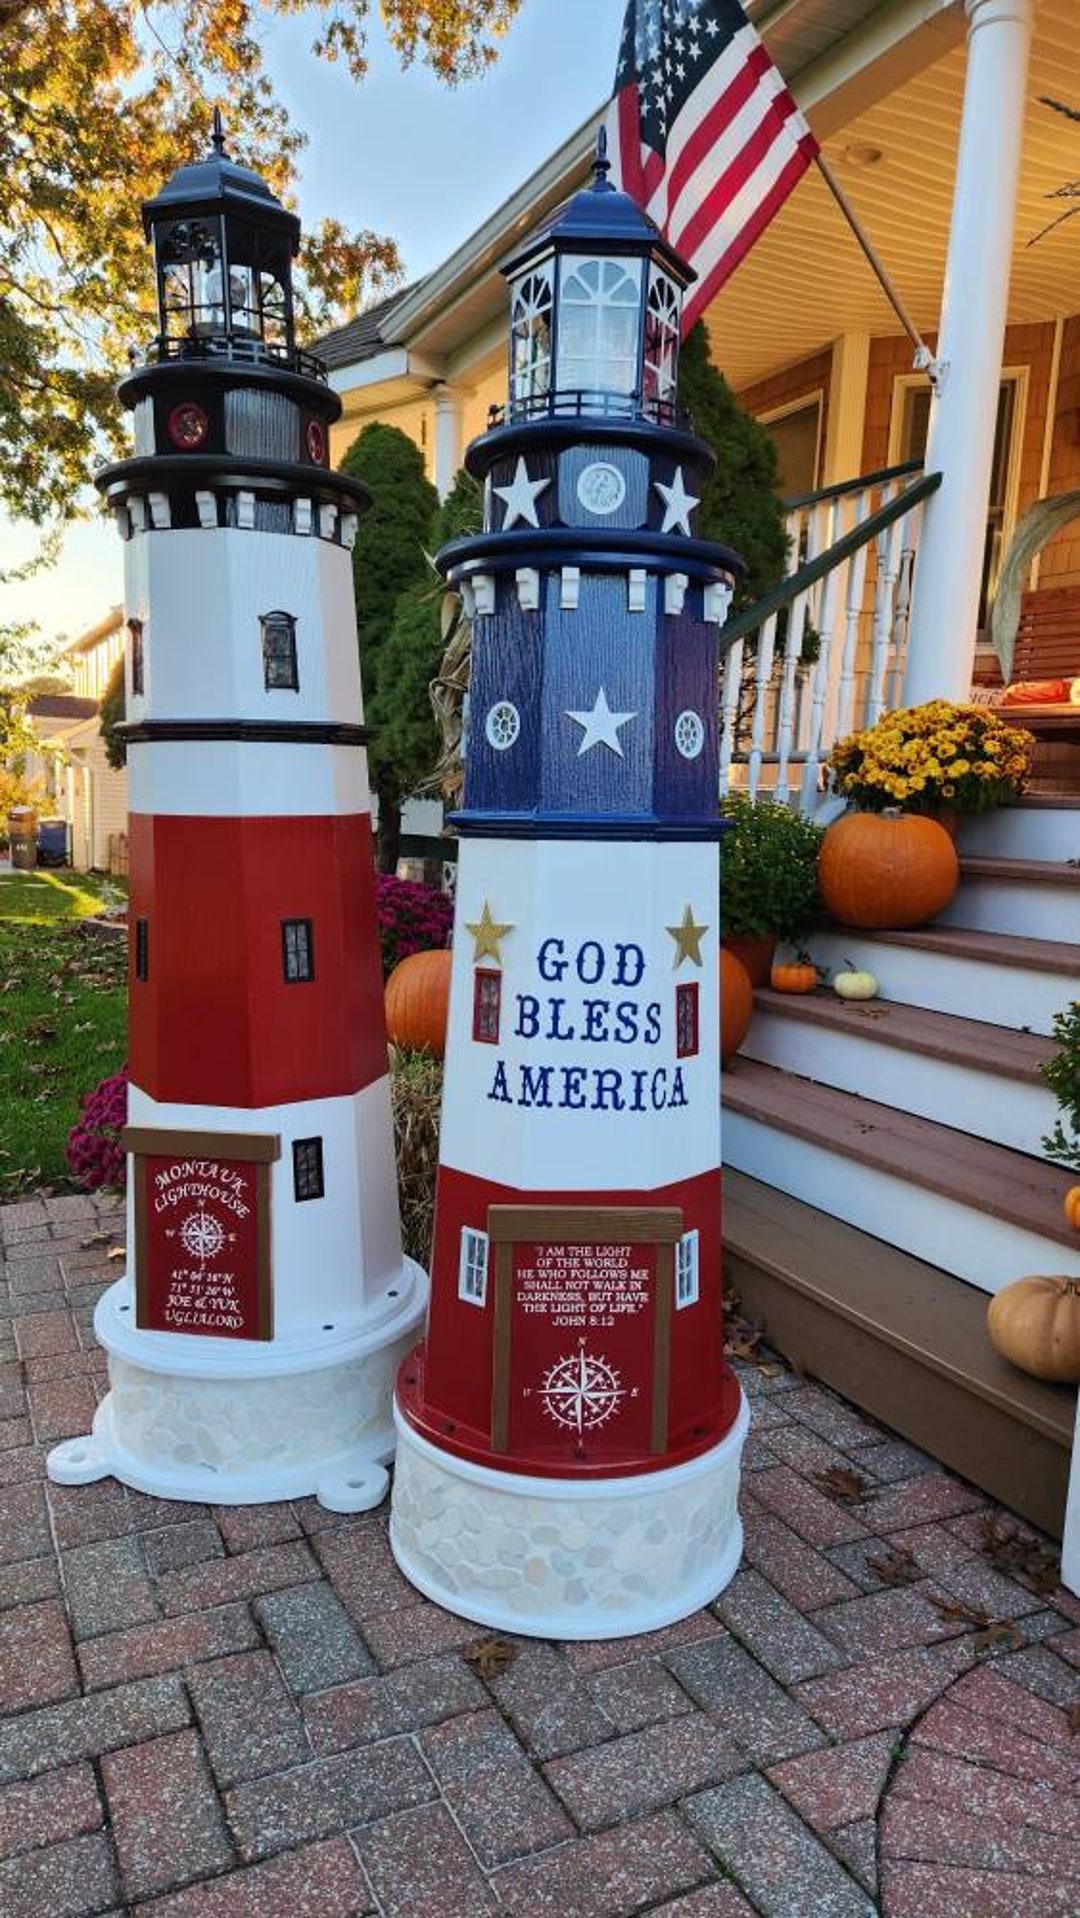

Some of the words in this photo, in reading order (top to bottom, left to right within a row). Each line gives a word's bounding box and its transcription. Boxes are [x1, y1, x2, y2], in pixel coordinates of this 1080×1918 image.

[537, 938, 646, 987] GOD
[514, 994, 661, 1045] BLESS
[487, 1060, 689, 1111] AMERICA
[155, 1160, 248, 1197] MONTAUK
[154, 1183, 250, 1218] LIGHTHOUSE
[546, 1247, 565, 1257] AM
[567, 1247, 592, 1257] THE
[596, 1247, 632, 1257] LIGHT
[536, 1258, 551, 1268] OF
[556, 1258, 580, 1268] THE
[583, 1258, 628, 1268] WORLD
[517, 1269, 535, 1279] HE
[538, 1269, 566, 1279] WHO
[571, 1269, 628, 1279] FOLLOWS
[630, 1269, 649, 1280] ME
[523, 1280, 562, 1290] SHALL
[565, 1280, 589, 1290] NOT
[592, 1281, 626, 1290] WALK
[629, 1281, 642, 1291] IN
[166, 1295, 192, 1307] JOE
[588, 1292, 613, 1301] BUT
[616, 1292, 649, 1302] HAVE
[522, 1303, 547, 1313] THE
[550, 1303, 587, 1313] LIGHT
[589, 1303, 607, 1313] OF
[552, 1315, 586, 1326] JOHN
[588, 1315, 614, 1326] 8:12
